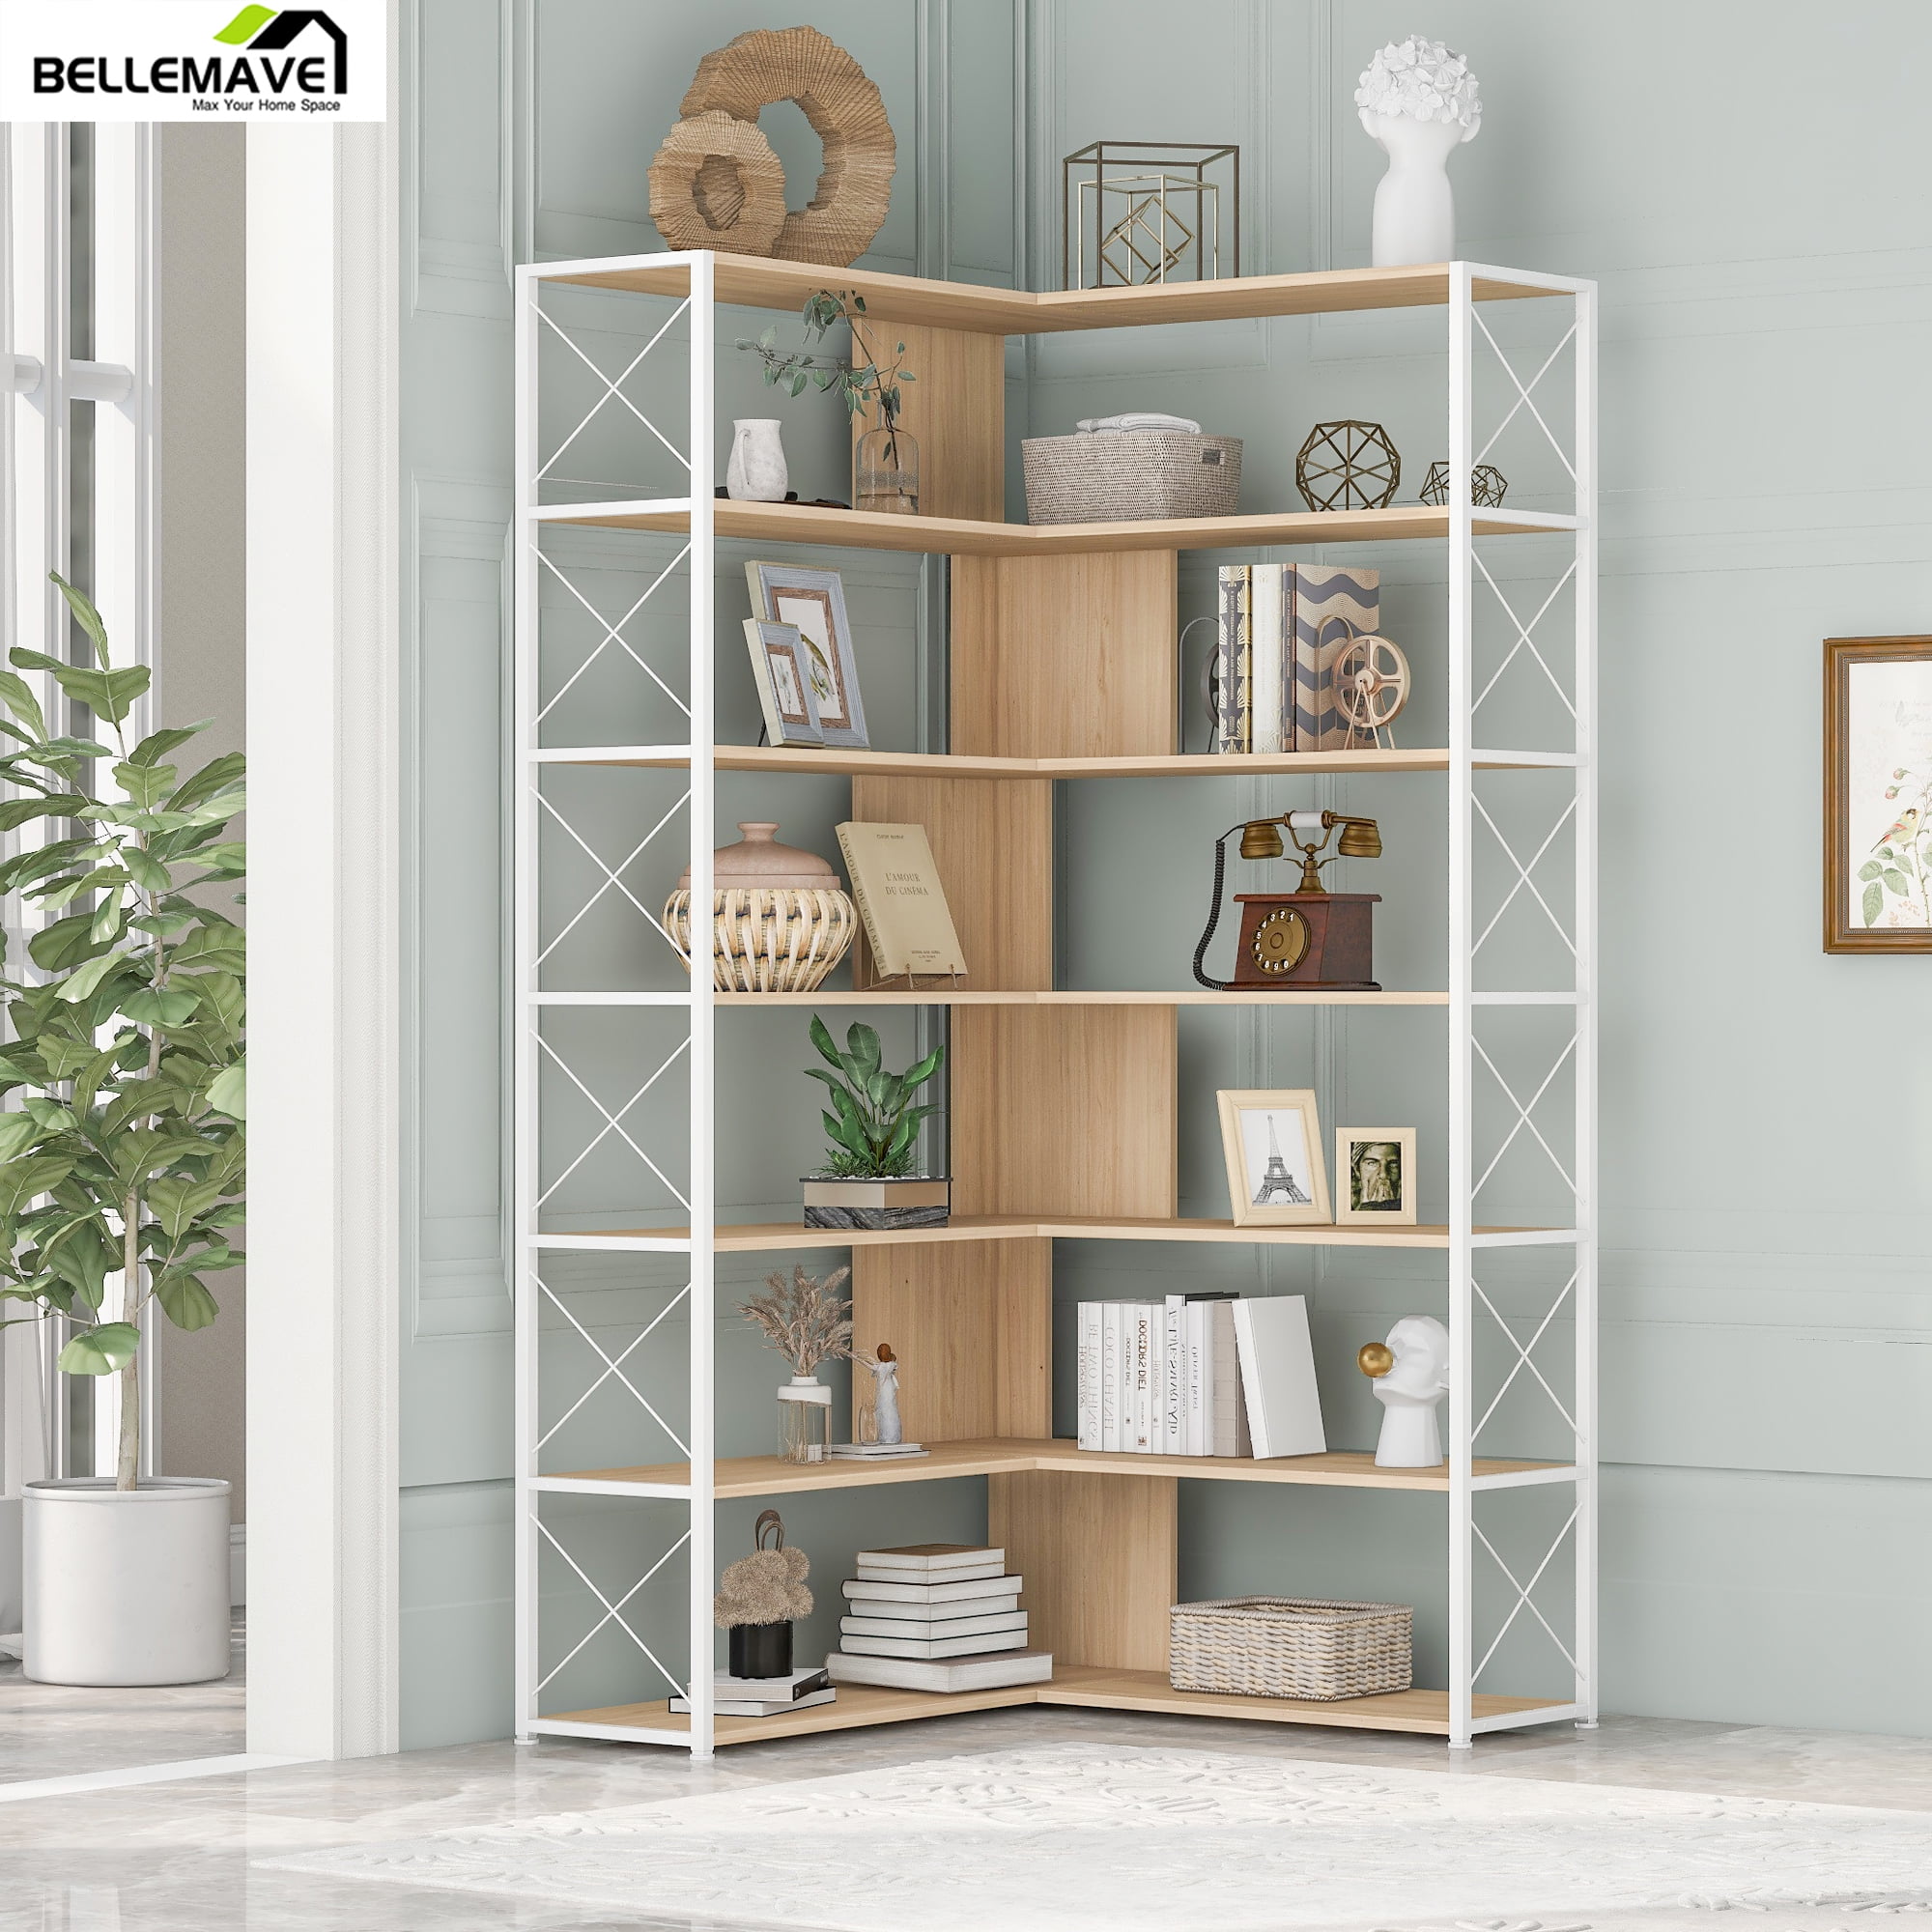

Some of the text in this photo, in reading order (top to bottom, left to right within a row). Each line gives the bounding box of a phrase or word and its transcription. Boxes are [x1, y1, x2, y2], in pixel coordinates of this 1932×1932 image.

[885, 872, 921, 882] L'AMOUR
[885, 886, 897, 895] DU
[1270, 913, 1276, 922] 3
[1280, 911, 1286, 920] 2
[1289, 913, 1294, 922] 1
[1261, 921, 1267, 929] 4
[1257, 931, 1262, 940] 5
[1255, 942, 1261, 951] 6
[1258, 953, 1264, 962] 7
[1264, 960, 1270, 969] 8
[1273, 962, 1279, 971] 9
